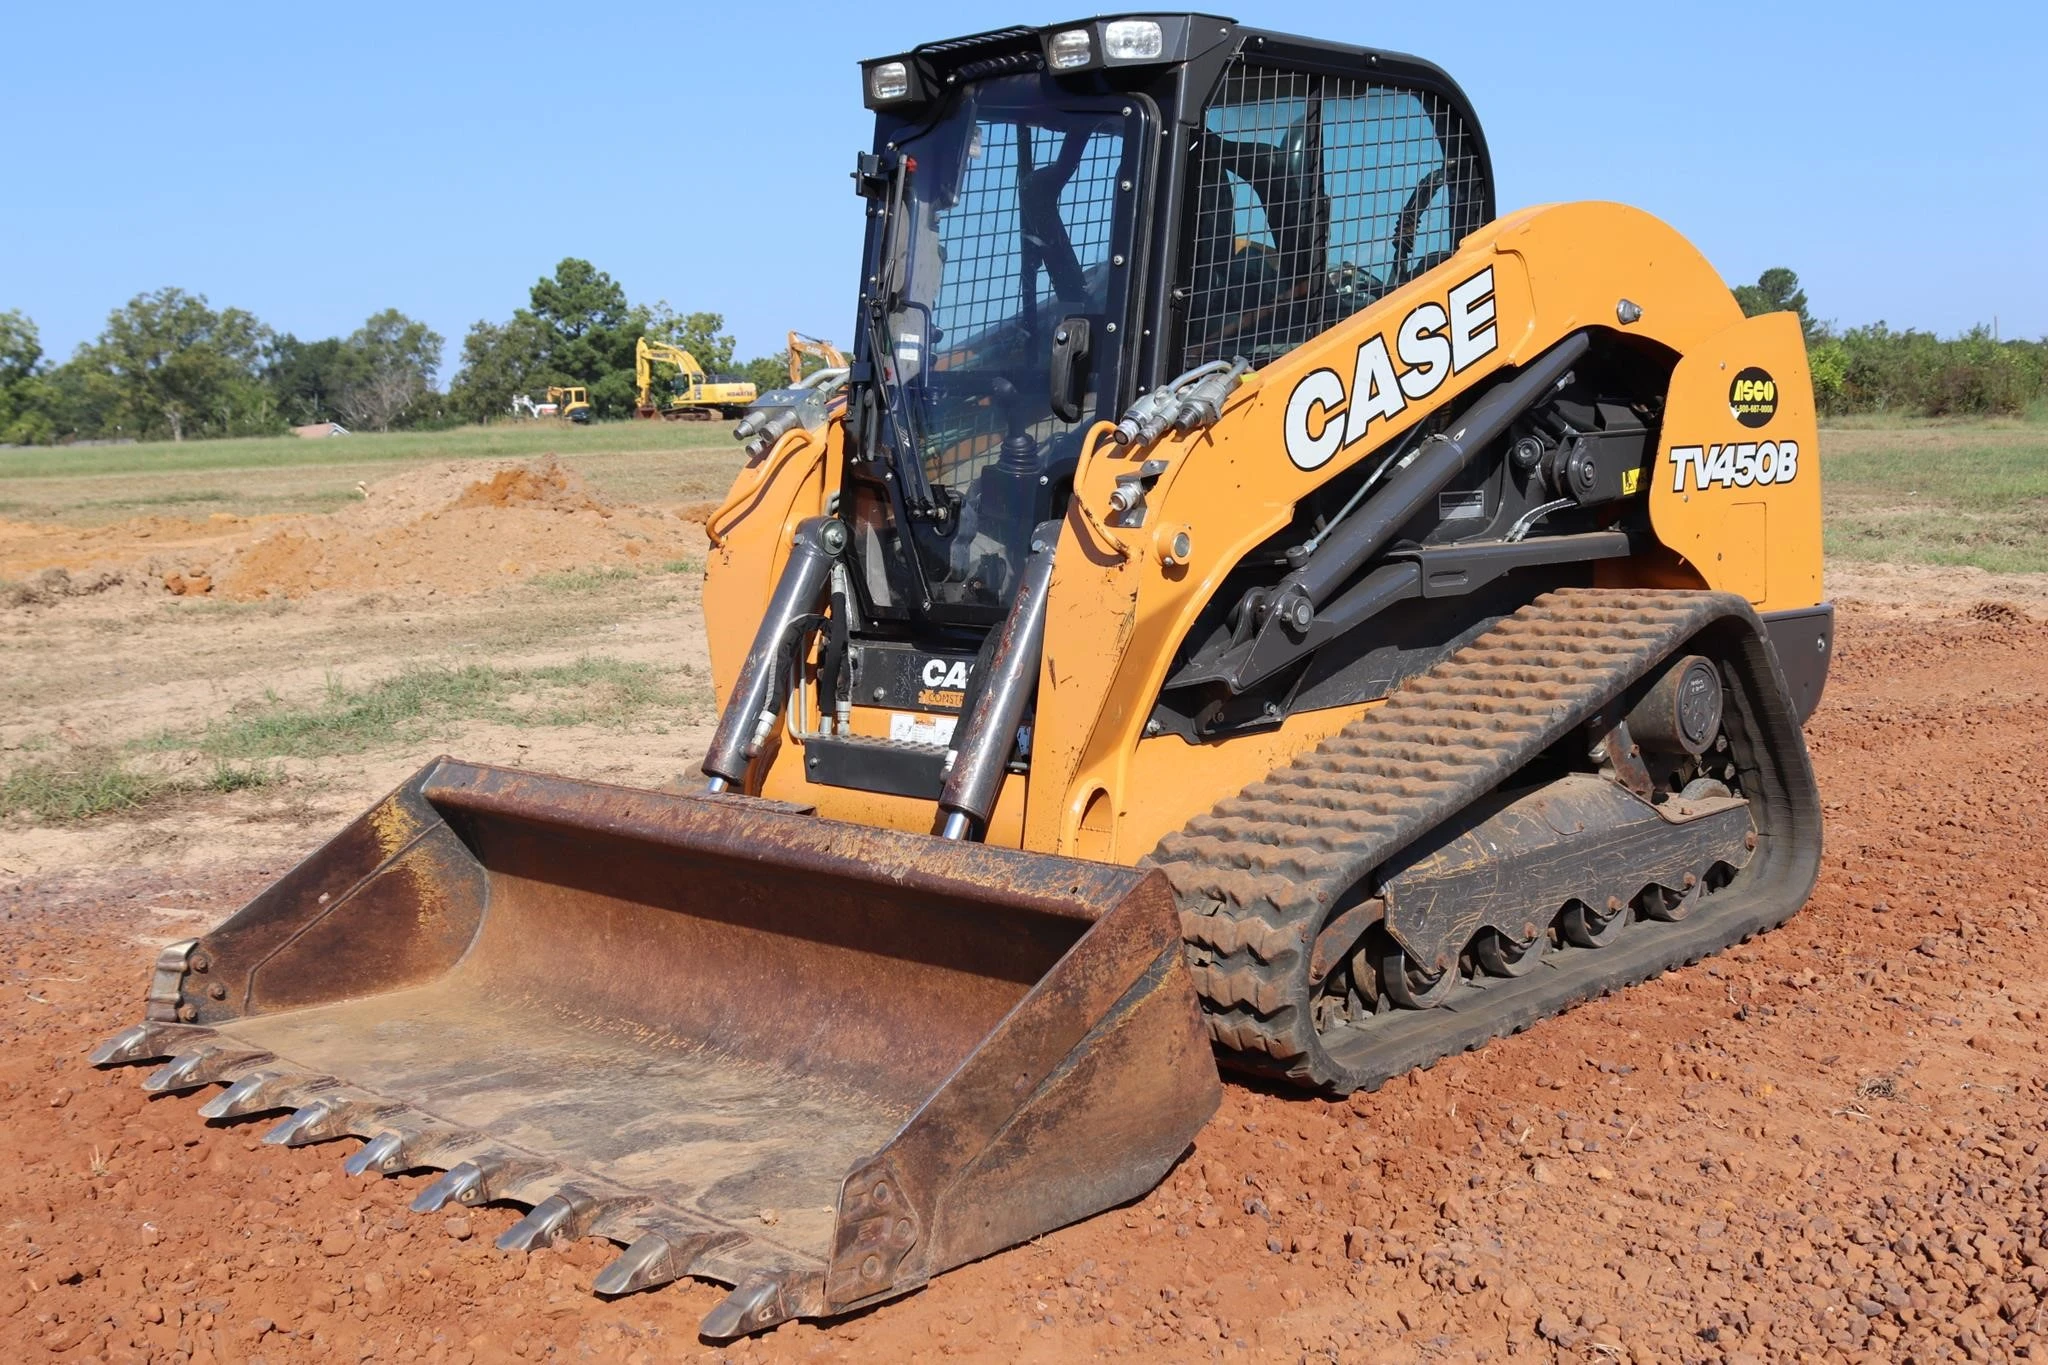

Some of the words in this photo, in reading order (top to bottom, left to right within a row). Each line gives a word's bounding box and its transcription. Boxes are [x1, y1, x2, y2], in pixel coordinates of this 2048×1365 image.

[1284, 264, 1498, 472] CASE
[1733, 380, 1774, 401] ASCO
[1669, 440, 1799, 493] TV450B
[922, 659, 975, 689] CA
